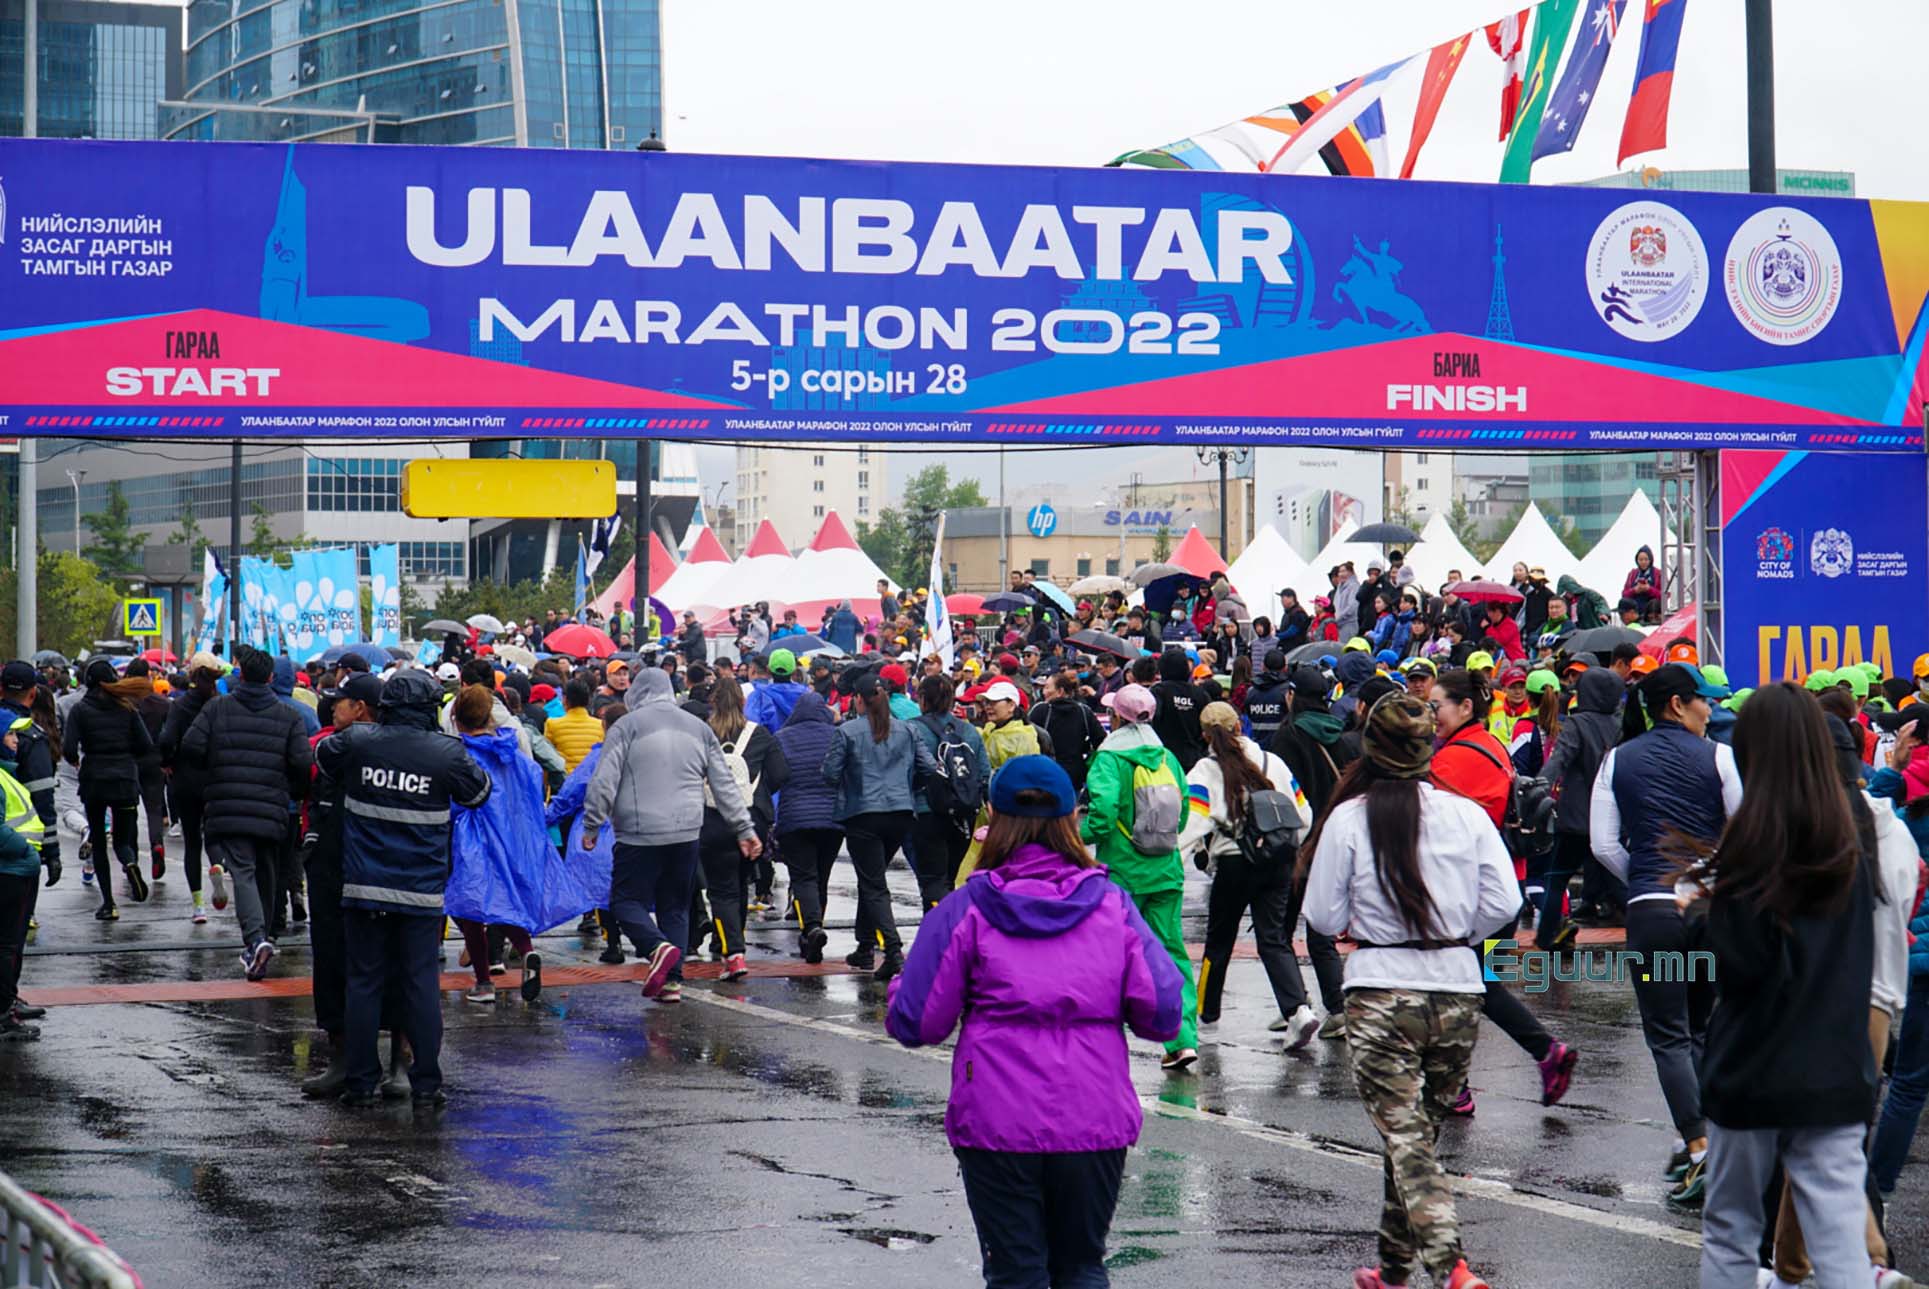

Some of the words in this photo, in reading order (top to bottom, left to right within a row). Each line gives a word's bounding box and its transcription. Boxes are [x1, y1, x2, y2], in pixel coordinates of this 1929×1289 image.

[21, 214, 162, 234] НИЙСЛЭЛИЙН
[406, 186, 1293, 285] ULAANBAATAR
[21, 239, 85, 254] ЗАСАГ
[89, 239, 172, 257] ДАРГЫН
[21, 259, 106, 276] ТАМГЫН
[111, 260, 173, 276] ГАЗАР
[479, 298, 968, 351] MARATHON
[991, 308, 1221, 355] 2022
[166, 332, 220, 359] ГАРАА
[1434, 353, 1480, 377] БАРИА
[106, 367, 280, 397] START
[731, 360, 790, 400] 5-р
[800, 369, 915, 401] сарын
[926, 363, 967, 395] 28
[1387, 384, 1527, 412] FINISH
[241, 416, 315, 426] УЛААНБААТАР
[318, 417, 372, 427] МАРАФОН
[375, 417, 397, 426] 2022
[399, 417, 431, 427] ОЛОН
[434, 417, 471, 427] УЛСЫН
[473, 416, 507, 427] ГҮЙЛТ
[725, 419, 795, 430] УЛААНБААТАР
[797, 421, 848, 431] МАРАФОН
[849, 422, 871, 431] 2022
[873, 422, 903, 432] ОЛОН
[905, 422, 940, 432] УЛСЫН
[1175, 425, 1241, 435] УЛААНБААТАР
[1242, 426, 1289, 436] МАРАФОН
[1290, 427, 1310, 436] 2022
[1312, 427, 1340, 437] ОЛОН
[1342, 427, 1374, 437] УЛСЫН
[1589, 430, 1649, 440] УЛААНБААТАР
[1650, 431, 1694, 440] МАРАФОН
[1694, 432, 1713, 441] 2022
[1713, 432, 1740, 441] ОЛОН
[1740, 432, 1770, 442] УЛСЫН
[1032, 503, 1054, 537] hp
[1104, 510, 1173, 526] SAIN
[1757, 571, 1794, 579] NOMADS
[1759, 561, 1777, 570] CITY
[1778, 561, 1791, 570] OF
[1757, 625, 1895, 687] ГАРАА
[1250, 703, 1280, 714] POLICE
[361, 766, 432, 795] POLICE
